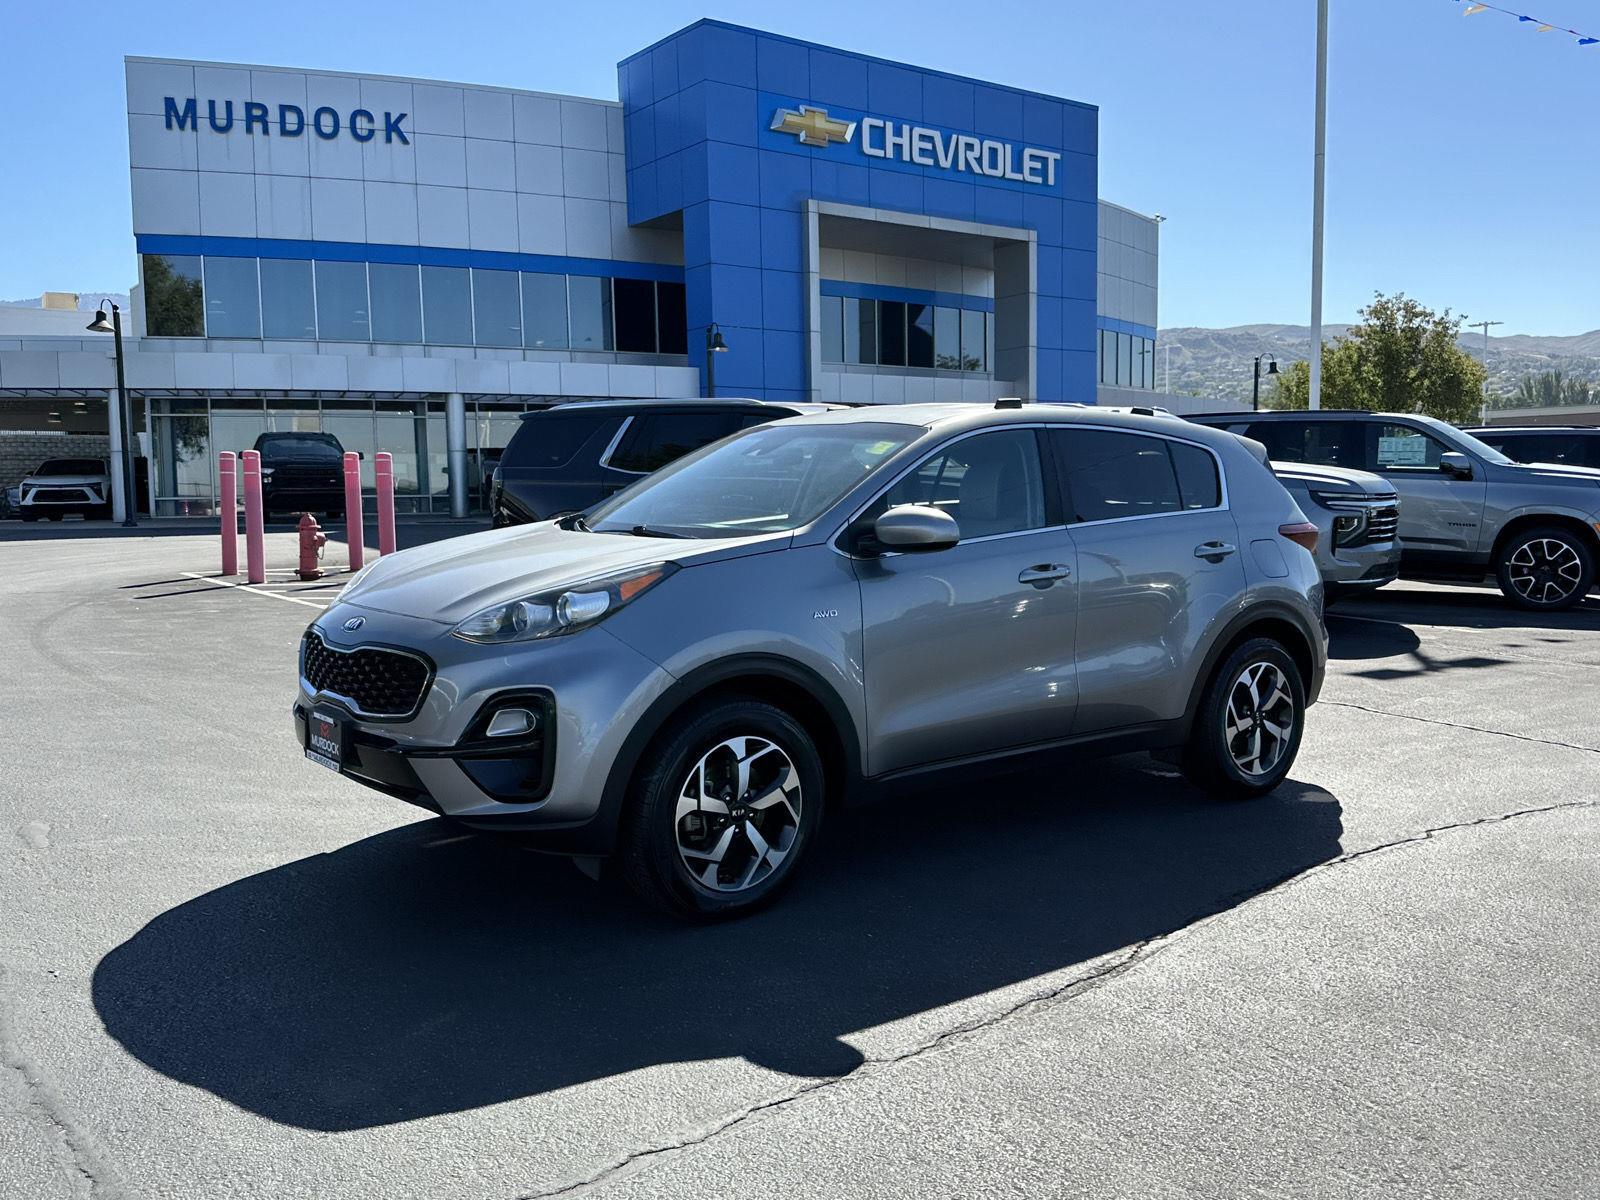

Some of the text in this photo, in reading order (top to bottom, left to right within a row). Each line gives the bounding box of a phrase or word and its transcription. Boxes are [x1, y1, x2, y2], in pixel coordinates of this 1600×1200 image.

[164, 96, 411, 146] MURDOCK
[861, 116, 1061, 186] CHEVROLET
[813, 609, 838, 619] AWD
[311, 733, 339, 756] MURDOCK
[731, 808, 745, 817] KIA
